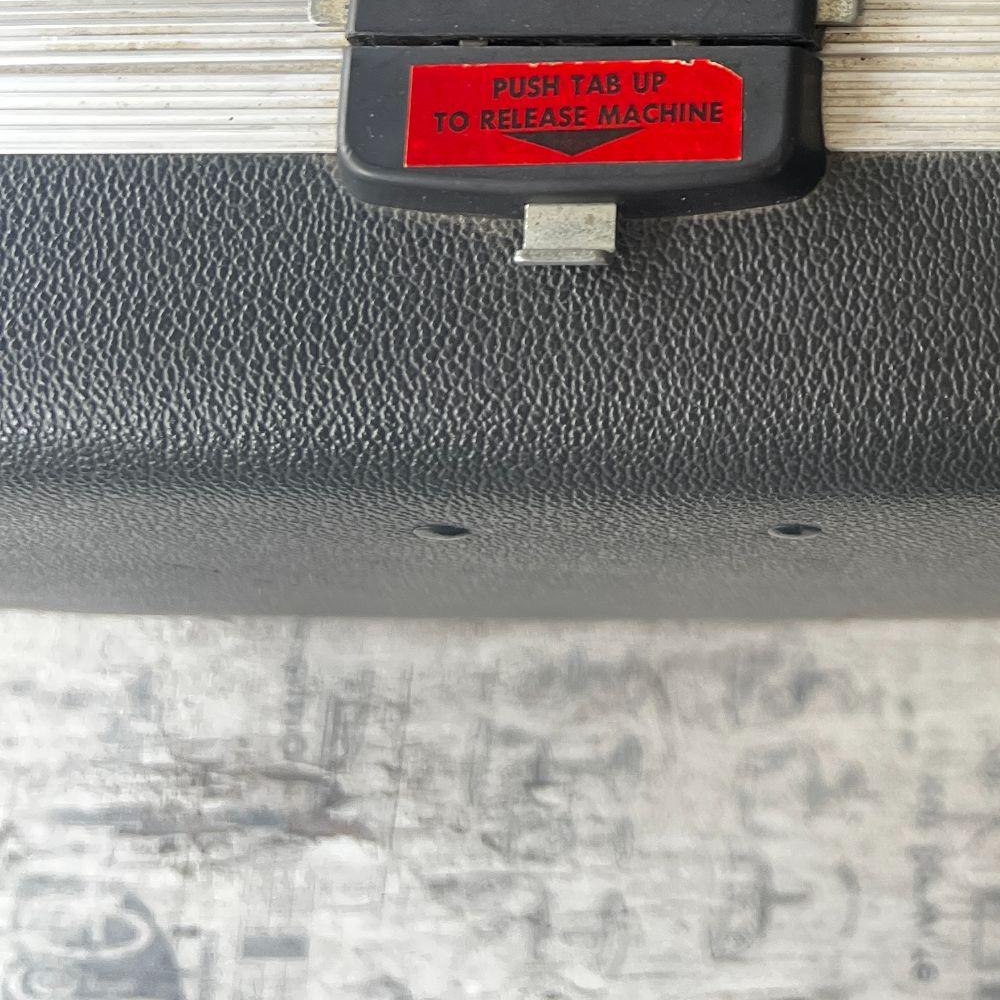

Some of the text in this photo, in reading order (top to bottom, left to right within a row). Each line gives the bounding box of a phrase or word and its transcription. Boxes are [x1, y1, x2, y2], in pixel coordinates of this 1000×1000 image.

[492, 72, 667, 99] PUSH TAB UP
[433, 101, 723, 132] TO RELEASE MACHINE
